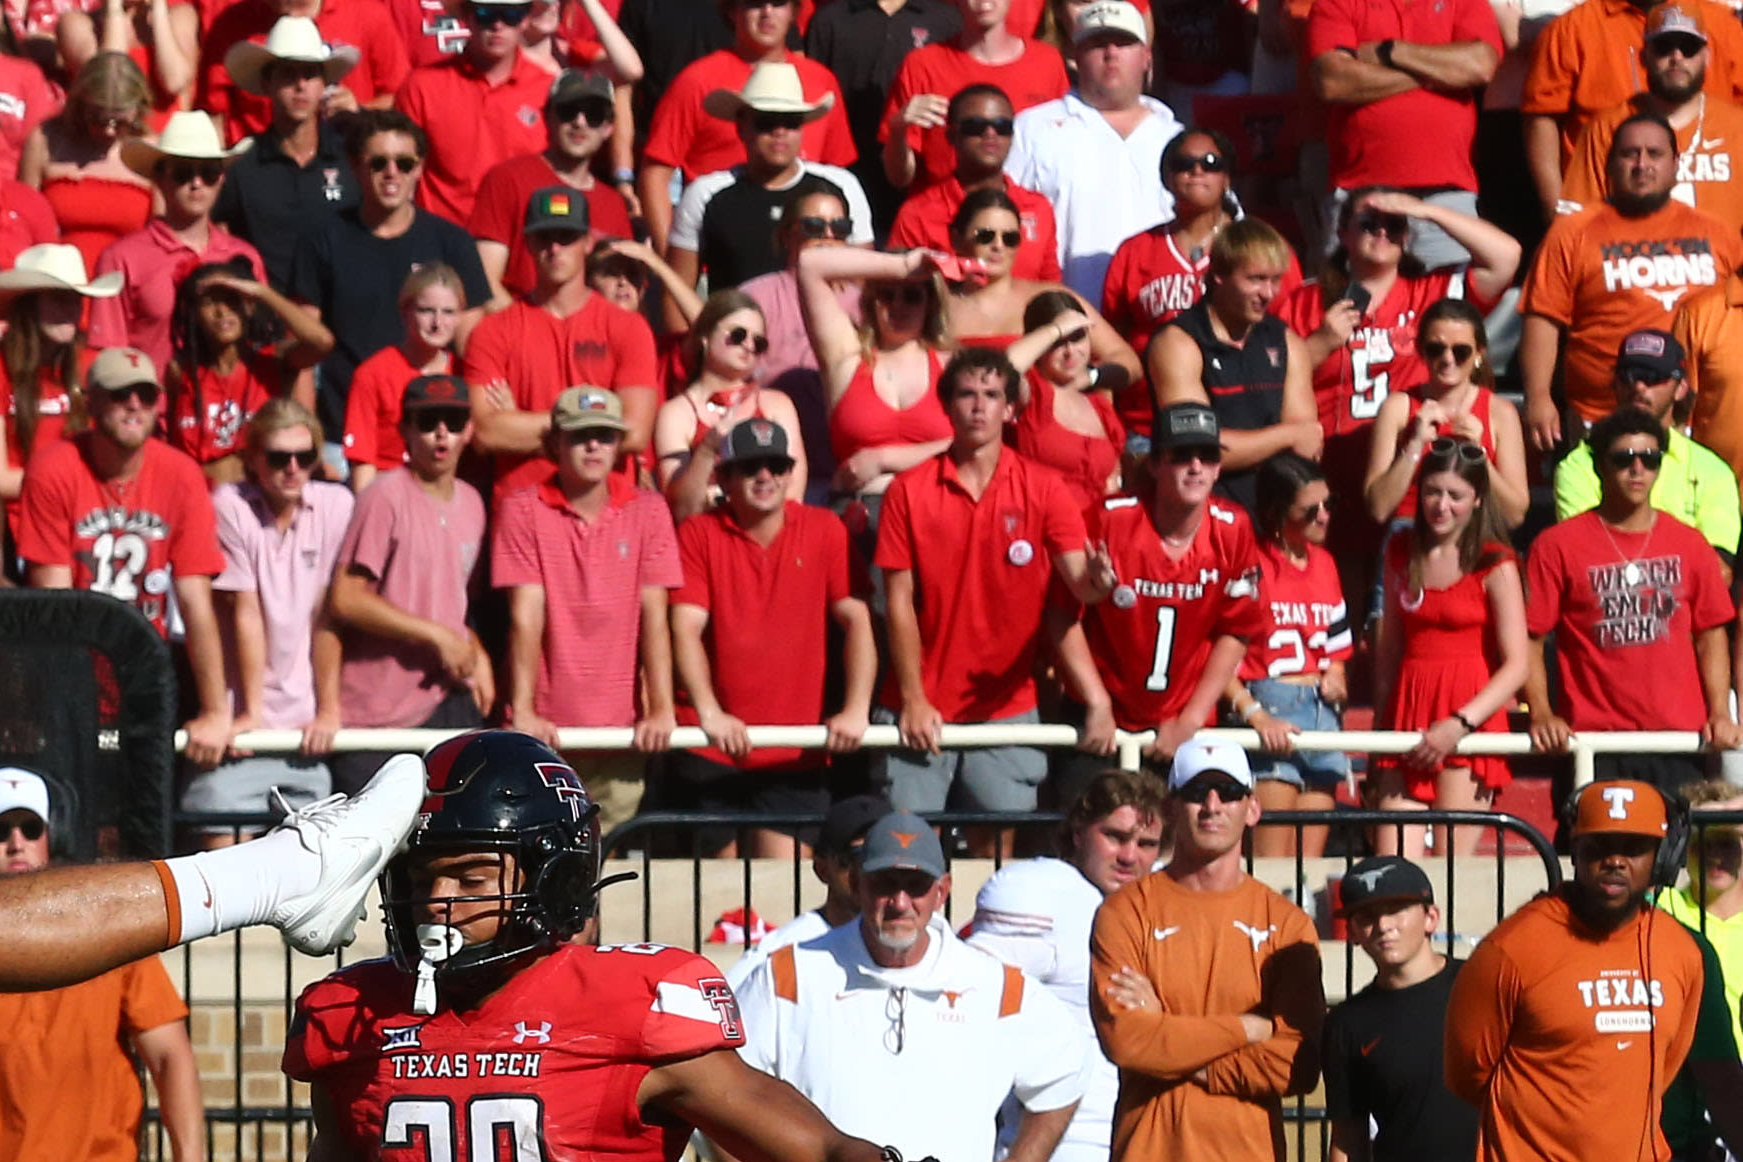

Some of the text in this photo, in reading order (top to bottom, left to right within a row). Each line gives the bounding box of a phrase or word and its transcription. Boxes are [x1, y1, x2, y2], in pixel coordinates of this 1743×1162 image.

[1676, 153, 1731, 182] XAS
[1603, 252, 1717, 292] HORNS
[89, 533, 149, 600] 12
[1146, 606, 1175, 691] 1
[1578, 979, 1664, 1008] TEXAS
[392, 1053, 541, 1078] TEXAS TECH
